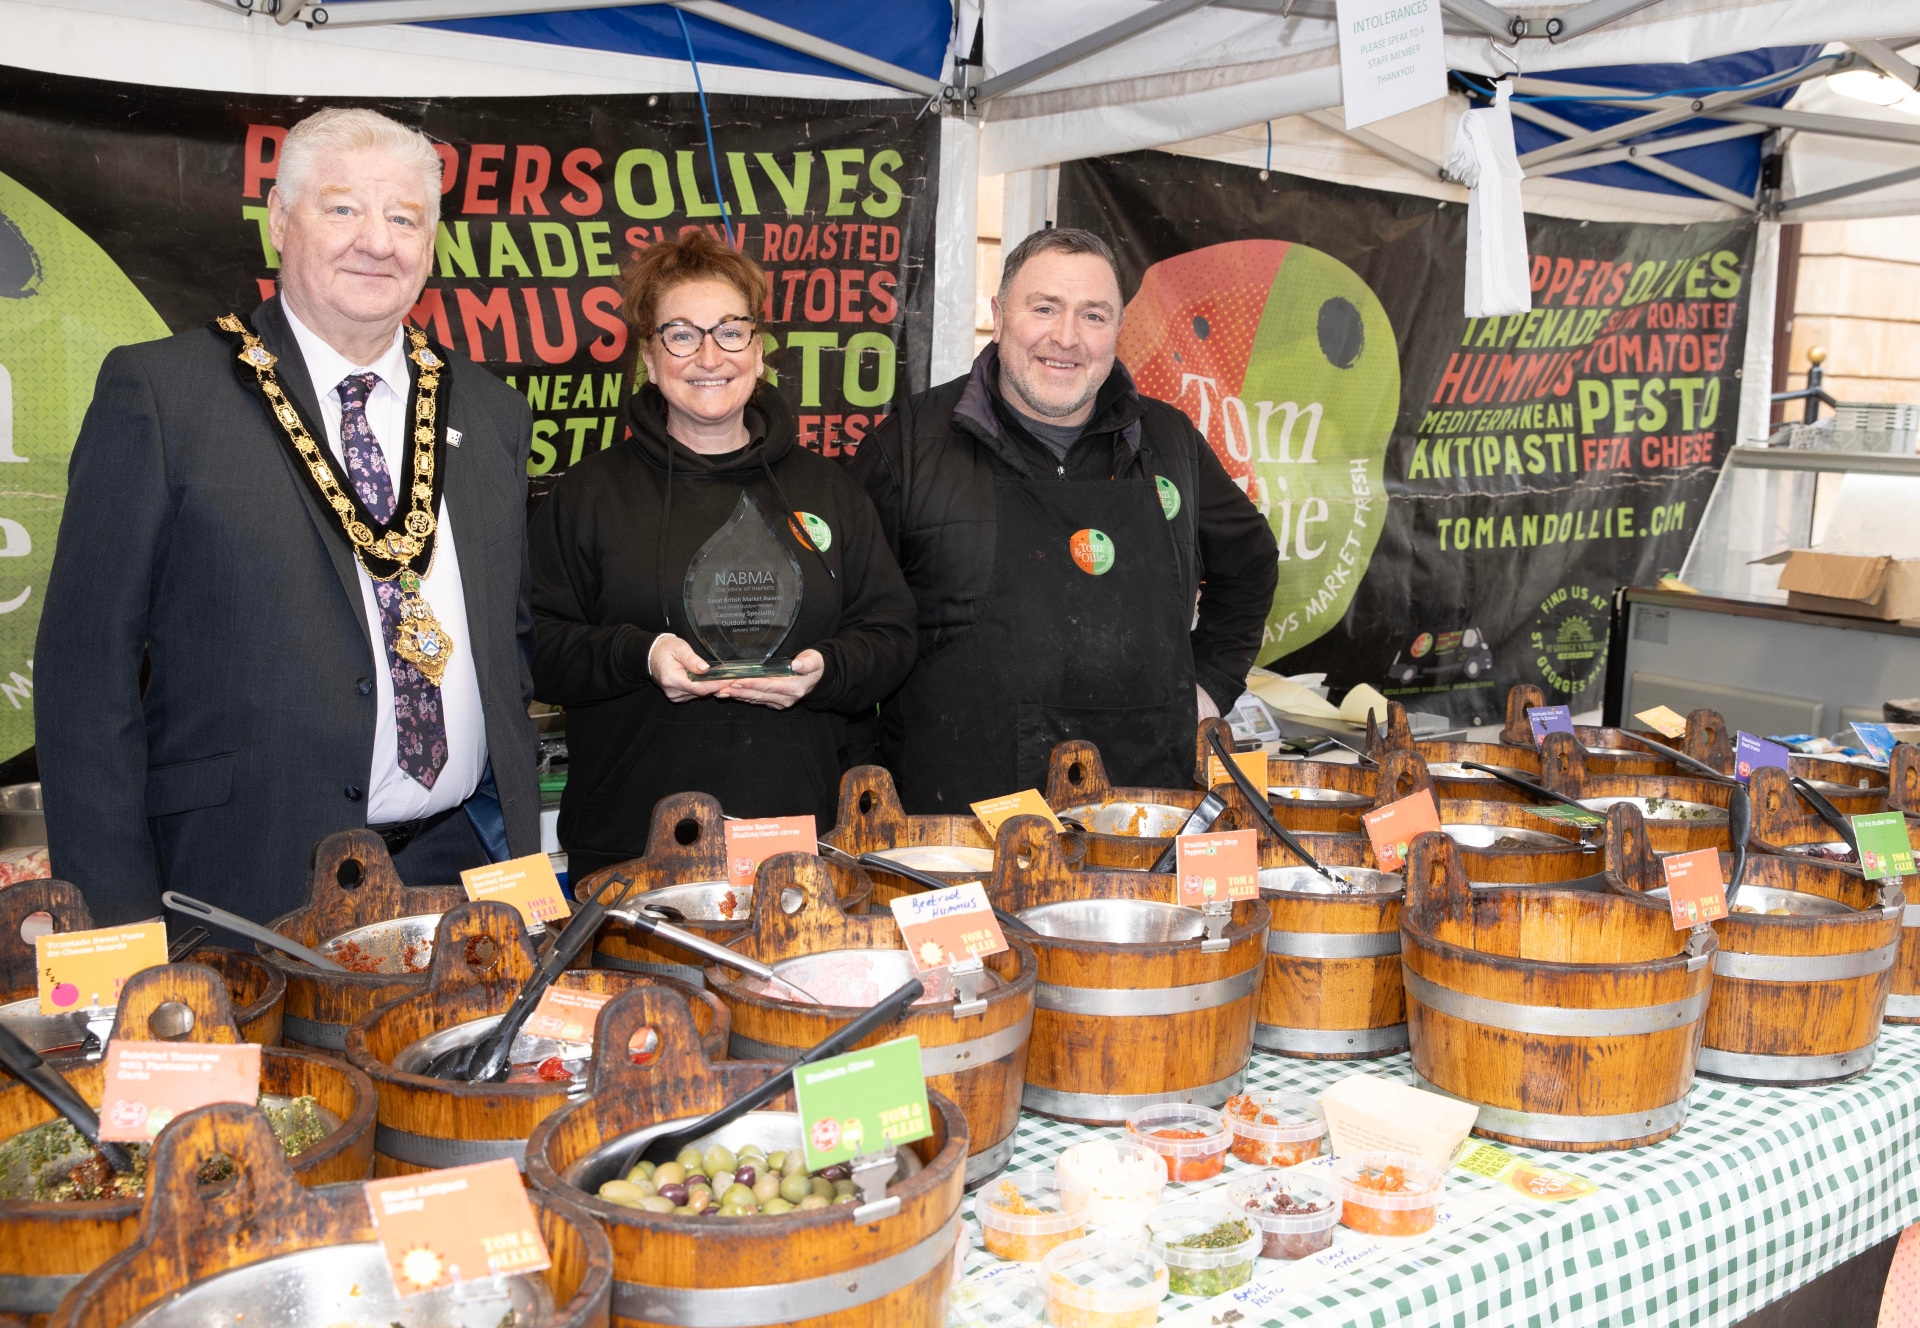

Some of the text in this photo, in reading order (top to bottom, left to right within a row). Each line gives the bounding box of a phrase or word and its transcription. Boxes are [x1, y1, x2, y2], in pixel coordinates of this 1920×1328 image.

[1353, 0, 1428, 34] INTOLERANCES
[1360, 26, 1425, 54] PLEASE SPEAK TO A
[1368, 44, 1421, 68] STAFF MEMBER
[1377, 65, 1415, 84] THANKYOU
[614, 148, 903, 220] OLIVES
[242, 205, 621, 278] TNADE
[762, 223, 900, 262] ROASTED
[1528, 250, 1742, 307] PPERS OLIVES
[1433, 333, 1729, 405] HUMMUS TOMATOES
[1417, 376, 1720, 435] MEDITERRANEAN PESTO
[1182, 373, 1324, 464] Tom
[1408, 433, 1578, 480] ANTIPASTI
[1582, 437, 1632, 472] FETA
[1438, 502, 1686, 551] TOMANDOLLIE.COM
[1079, 543, 1104, 552] Tom
[1081, 553, 1105, 563] Ollie
[1262, 458, 1372, 647] AYS MARKET FRESH
[715, 571, 775, 586] NABMA
[1540, 586, 1608, 614] FIND US AT
[746, 610, 776, 618] Speciality
[1531, 632, 1543, 650] ST
[1537, 656, 1586, 694] GEORGES
[1228, 875, 1254, 886] TOM &
[1228, 885, 1255, 896] OLLIE
[526, 896, 555, 909] TOM &
[530, 905, 559, 919] OLLIE
[912, 889, 961, 914] Beetroot
[1700, 896, 1714, 907] TOM
[1702, 905, 1721, 917] OLLIE
[93, 935, 119, 944] Sweet
[121, 932, 145, 941] Paste
[960, 929, 993, 944] TOM &
[965, 938, 997, 955] OLLIE
[47, 942, 127, 958] for Cheese Boards
[878, 1102, 922, 1126] TOM &
[882, 1117, 925, 1140] OLLIE
[1460, 1145, 1493, 1168] ALWAYS
[1480, 1153, 1515, 1177] FRESH
[480, 1232, 520, 1253] TOM
